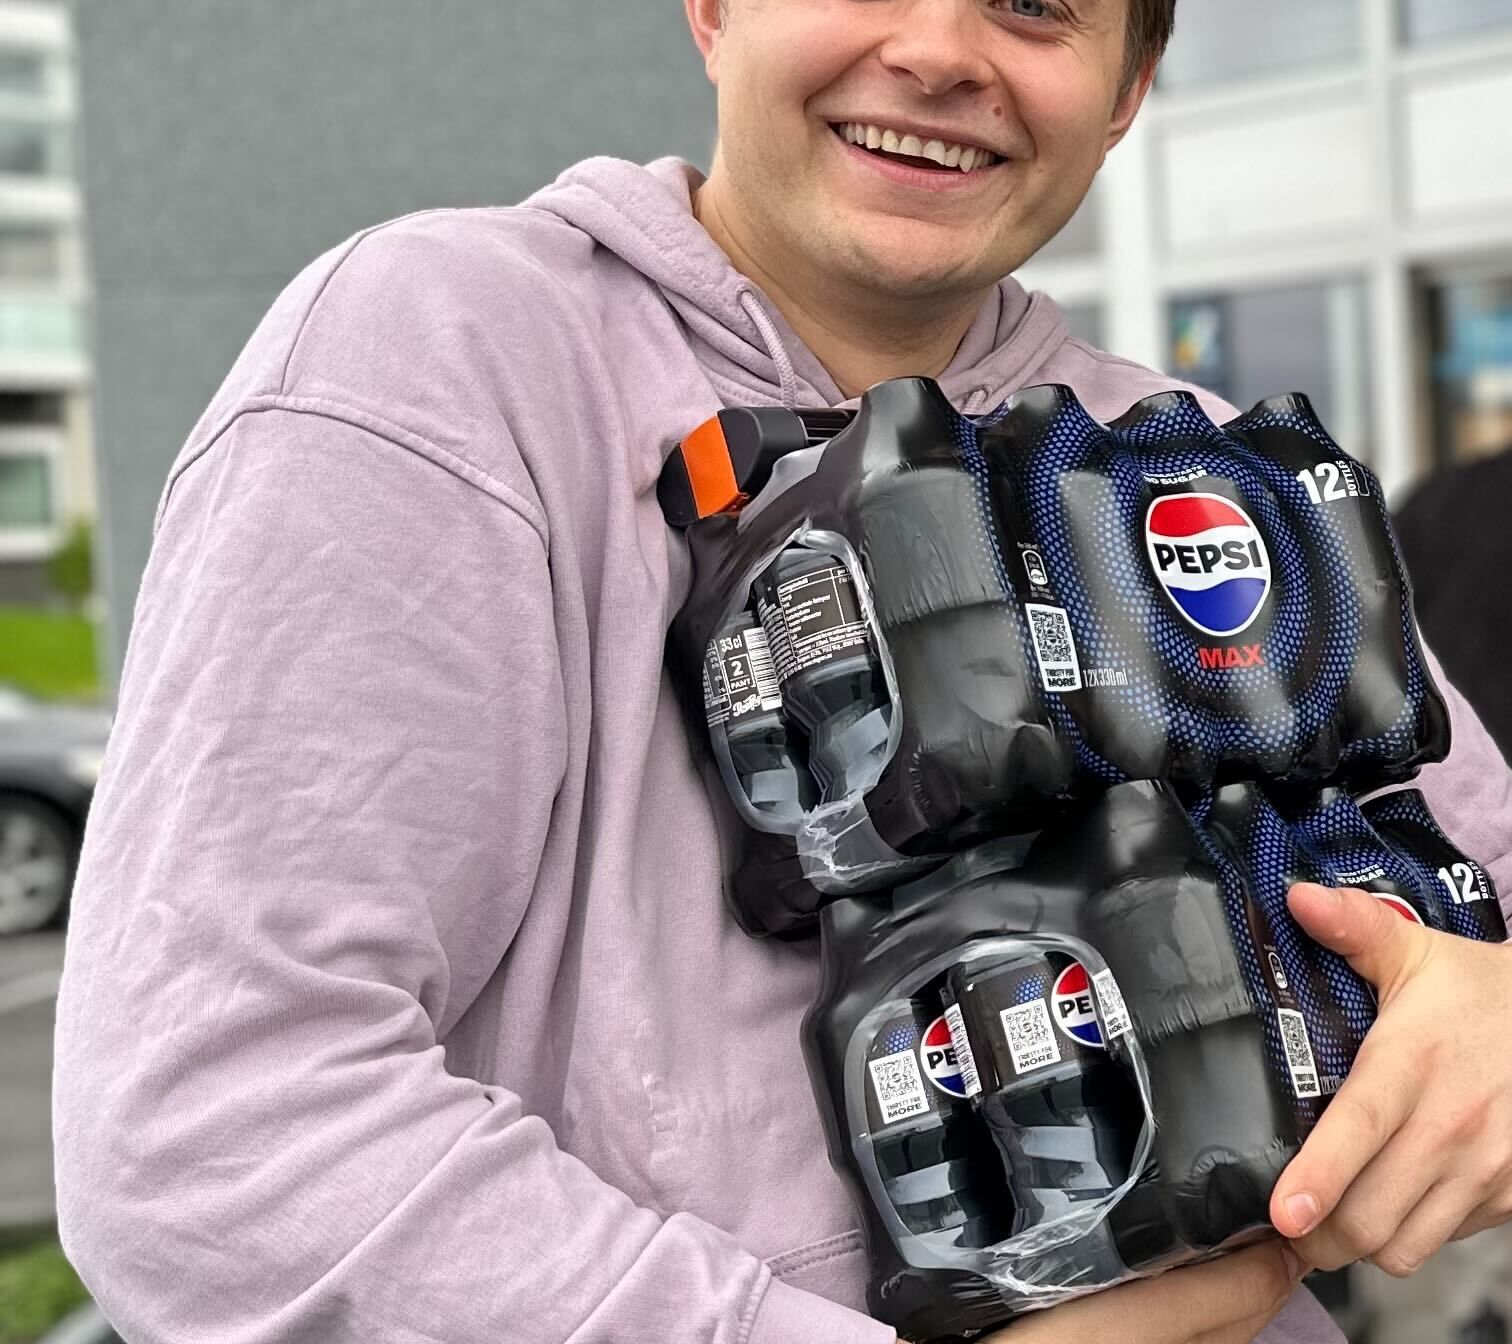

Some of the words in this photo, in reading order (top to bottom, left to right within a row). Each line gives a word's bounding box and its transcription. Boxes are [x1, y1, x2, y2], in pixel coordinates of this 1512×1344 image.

[1160, 469, 1208, 485] SUGAR
[1296, 462, 1347, 505] 12
[1153, 539, 1264, 574] PEPSI
[1199, 644, 1265, 669] MAX
[730, 660, 744, 677] 2
[730, 678, 752, 690] PANT
[1047, 677, 1077, 687] MORE
[1083, 667, 1128, 688] 12X330ml
[1437, 862, 1481, 904] 12
[1019, 1052, 1054, 1069] MORE
[887, 1103, 922, 1119] MORE
